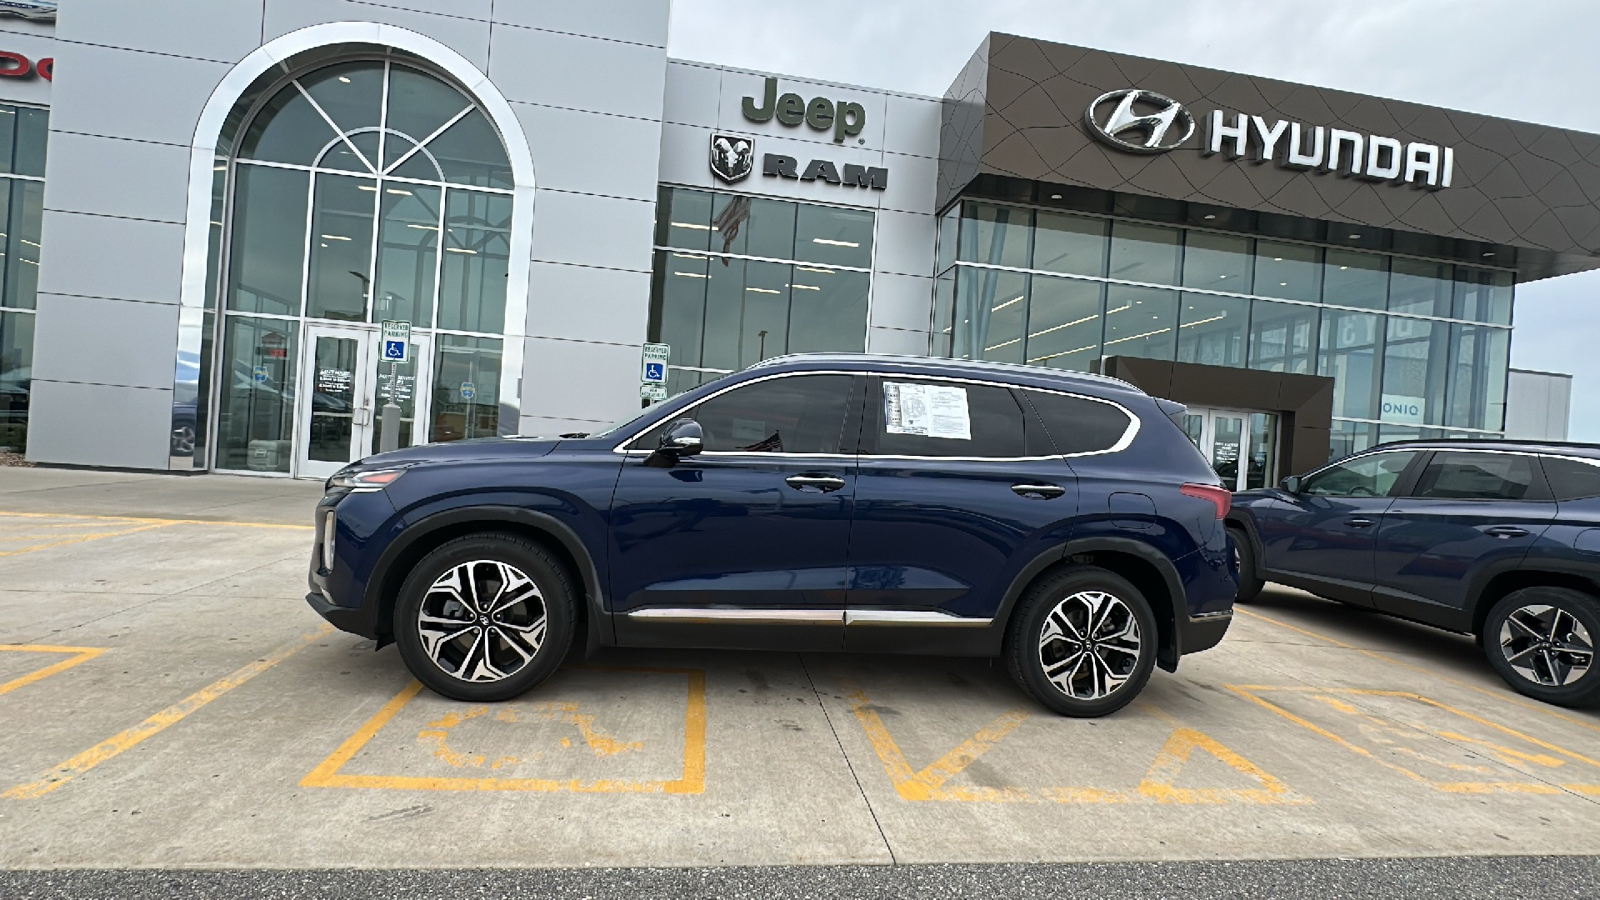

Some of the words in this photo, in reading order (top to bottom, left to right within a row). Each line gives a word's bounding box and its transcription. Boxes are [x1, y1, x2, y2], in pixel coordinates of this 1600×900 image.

[742, 77, 866, 143] Jeep
[1207, 109, 1454, 189] HYUNDAI
[763, 153, 889, 190] RAM
[383, 330, 409, 338] PARKING
[384, 322, 409, 331] RESERVED
[1382, 402, 1419, 416] ONIQ
